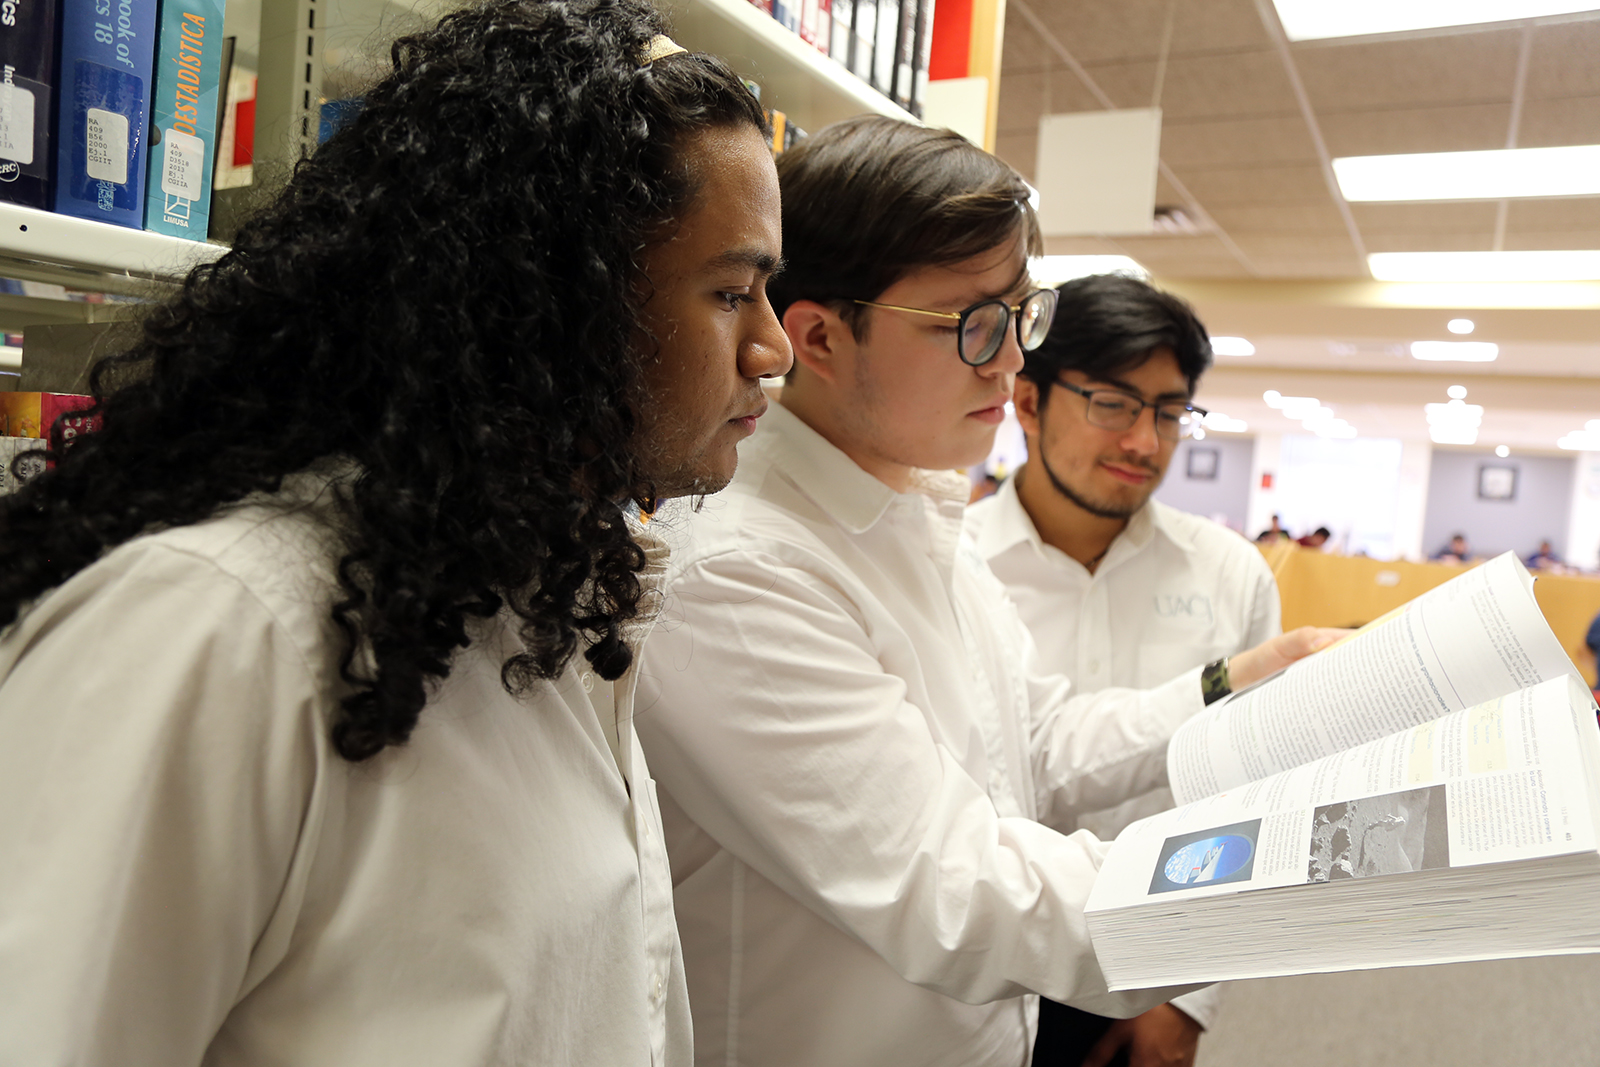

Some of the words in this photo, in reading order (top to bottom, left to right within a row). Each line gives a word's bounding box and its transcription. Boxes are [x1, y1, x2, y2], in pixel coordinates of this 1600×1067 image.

[94, 22, 113, 45] 18
[116, 43, 135, 68] of
[88, 125, 104, 134] 409
[88, 141, 108, 150] 2000
[170, 150, 182, 158] 409
[163, 215, 189, 228] LIMUSA
